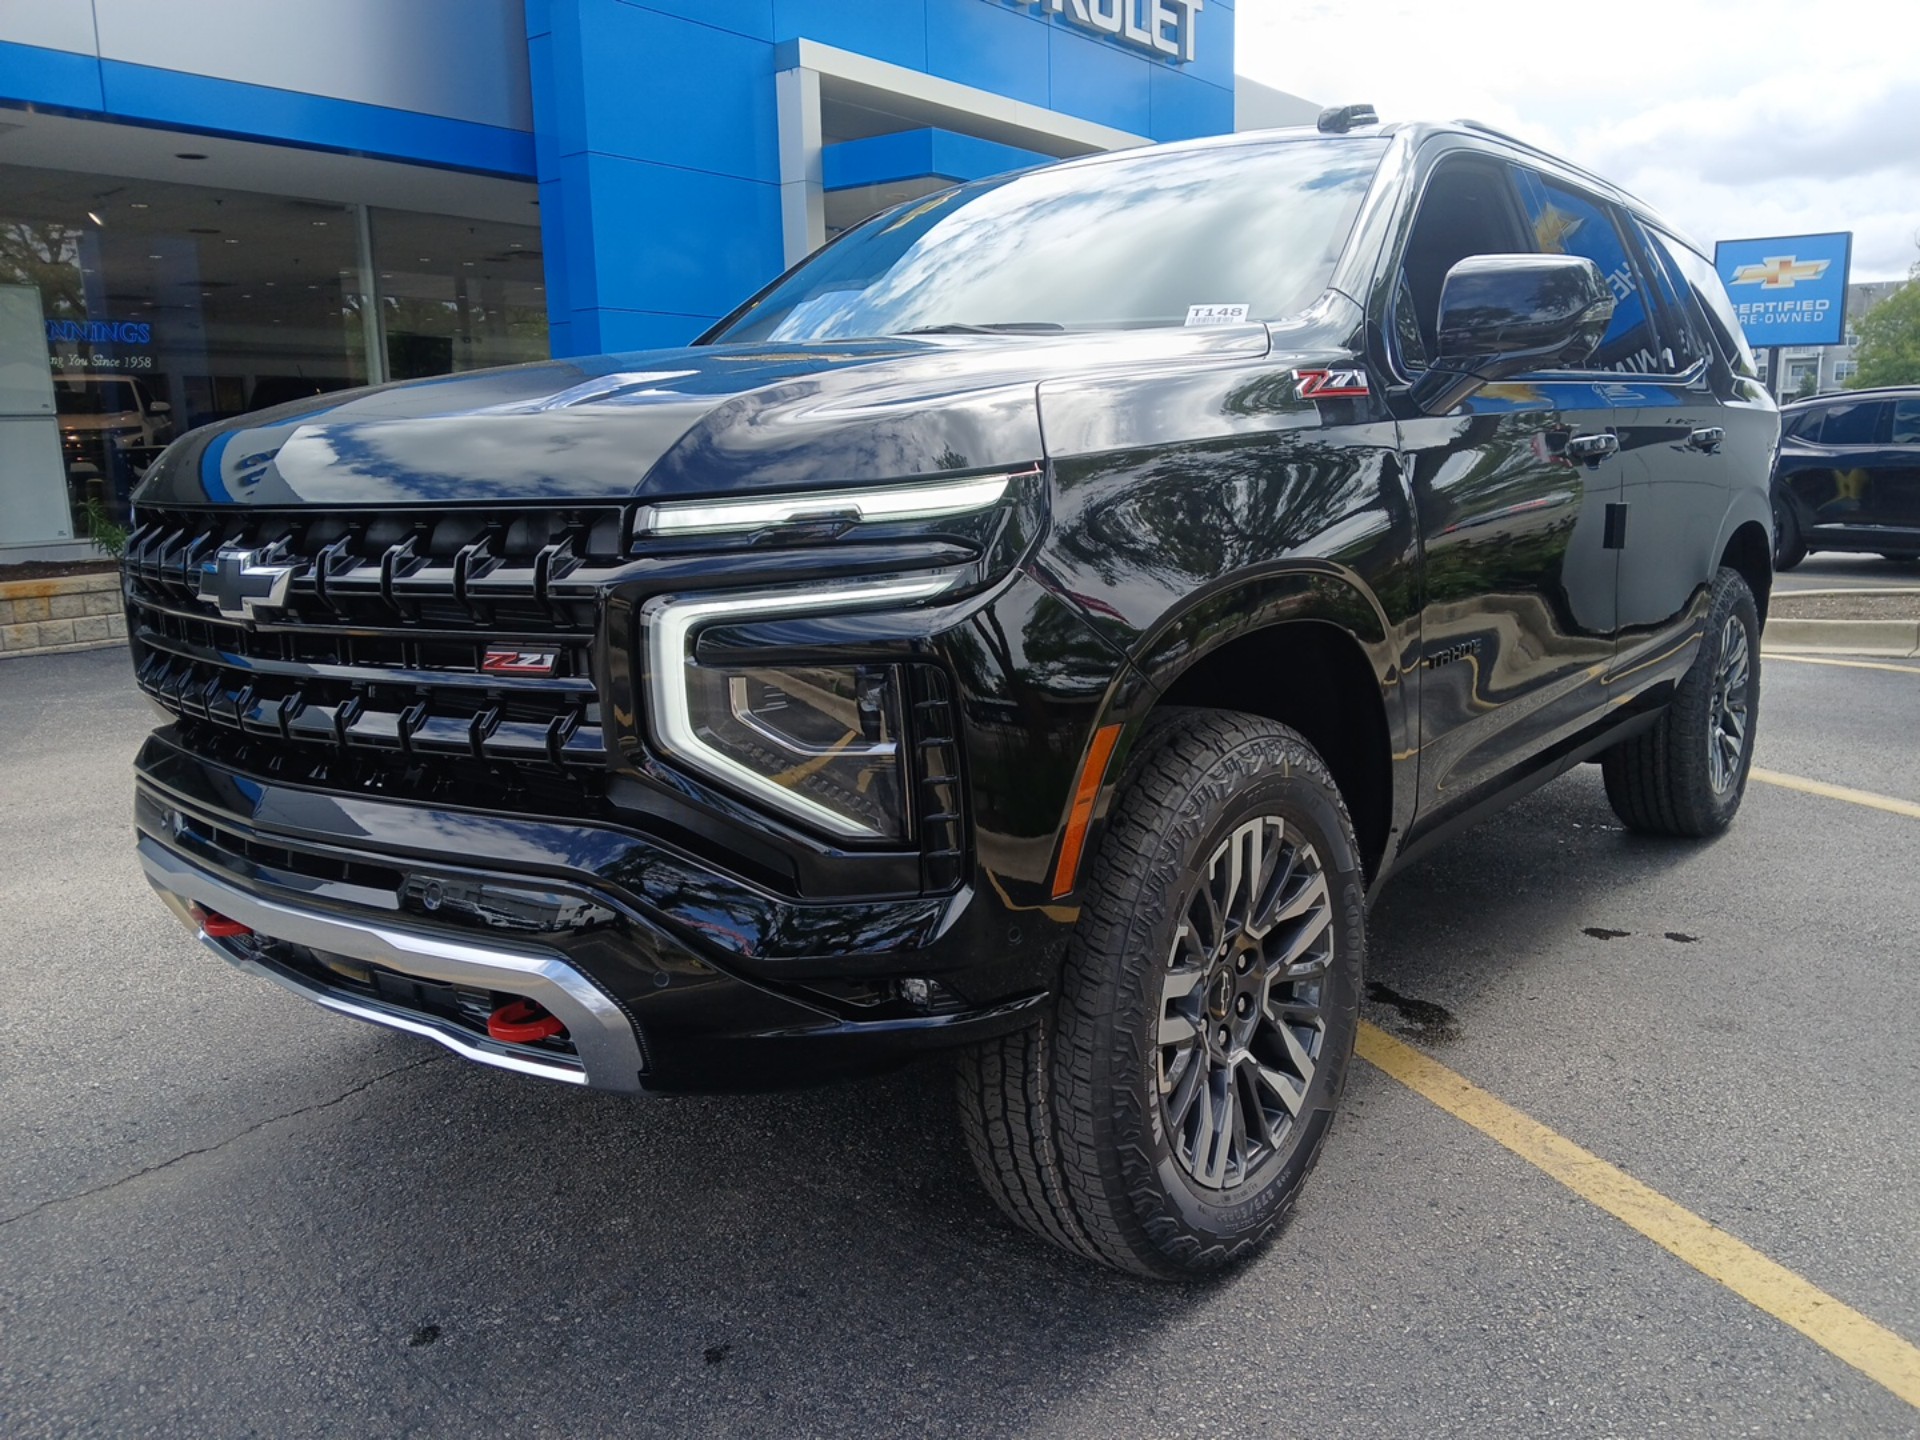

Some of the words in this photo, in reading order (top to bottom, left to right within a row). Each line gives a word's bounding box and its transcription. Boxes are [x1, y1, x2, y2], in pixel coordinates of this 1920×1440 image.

[1192, 307, 1243, 317] T148
[1739, 311, 1824, 325] RE-OWNED
[46, 320, 151, 344] NNINGS
[67, 353, 88, 367] You
[91, 354, 120, 368] Since
[124, 356, 152, 369] 1958
[1292, 368, 1370, 400] Z71
[482, 651, 555, 673] Z71
